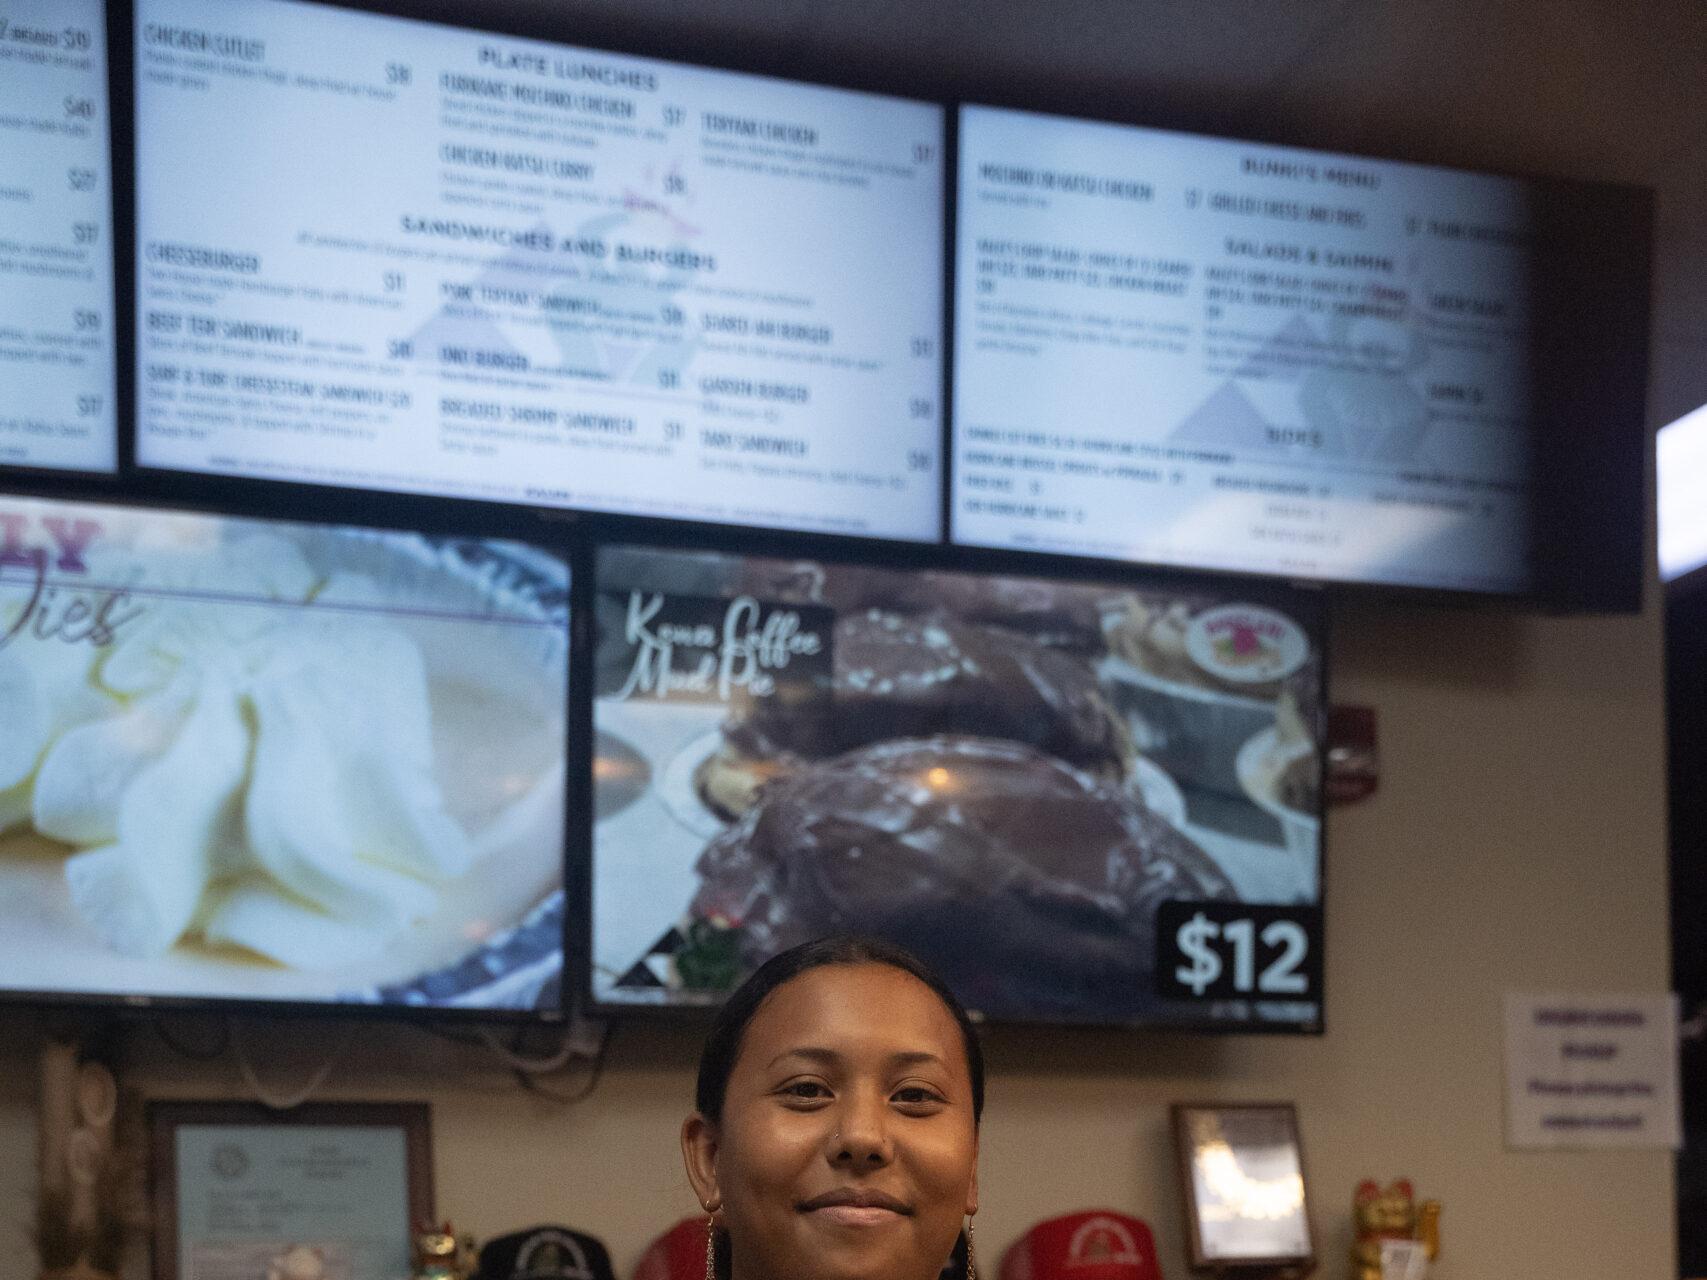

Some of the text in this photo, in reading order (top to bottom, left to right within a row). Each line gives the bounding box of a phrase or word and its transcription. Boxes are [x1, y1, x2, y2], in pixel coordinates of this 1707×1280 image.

[479, 47, 659, 92] PLATE LUNCHES
[402, 215, 553, 250] SANDWICHES
[560, 237, 607, 259] AND
[617, 244, 718, 272] BURGERS
[722, 596, 822, 669] Coffee
[718, 641, 776, 700] Pie
[1175, 910, 1311, 997] $12
